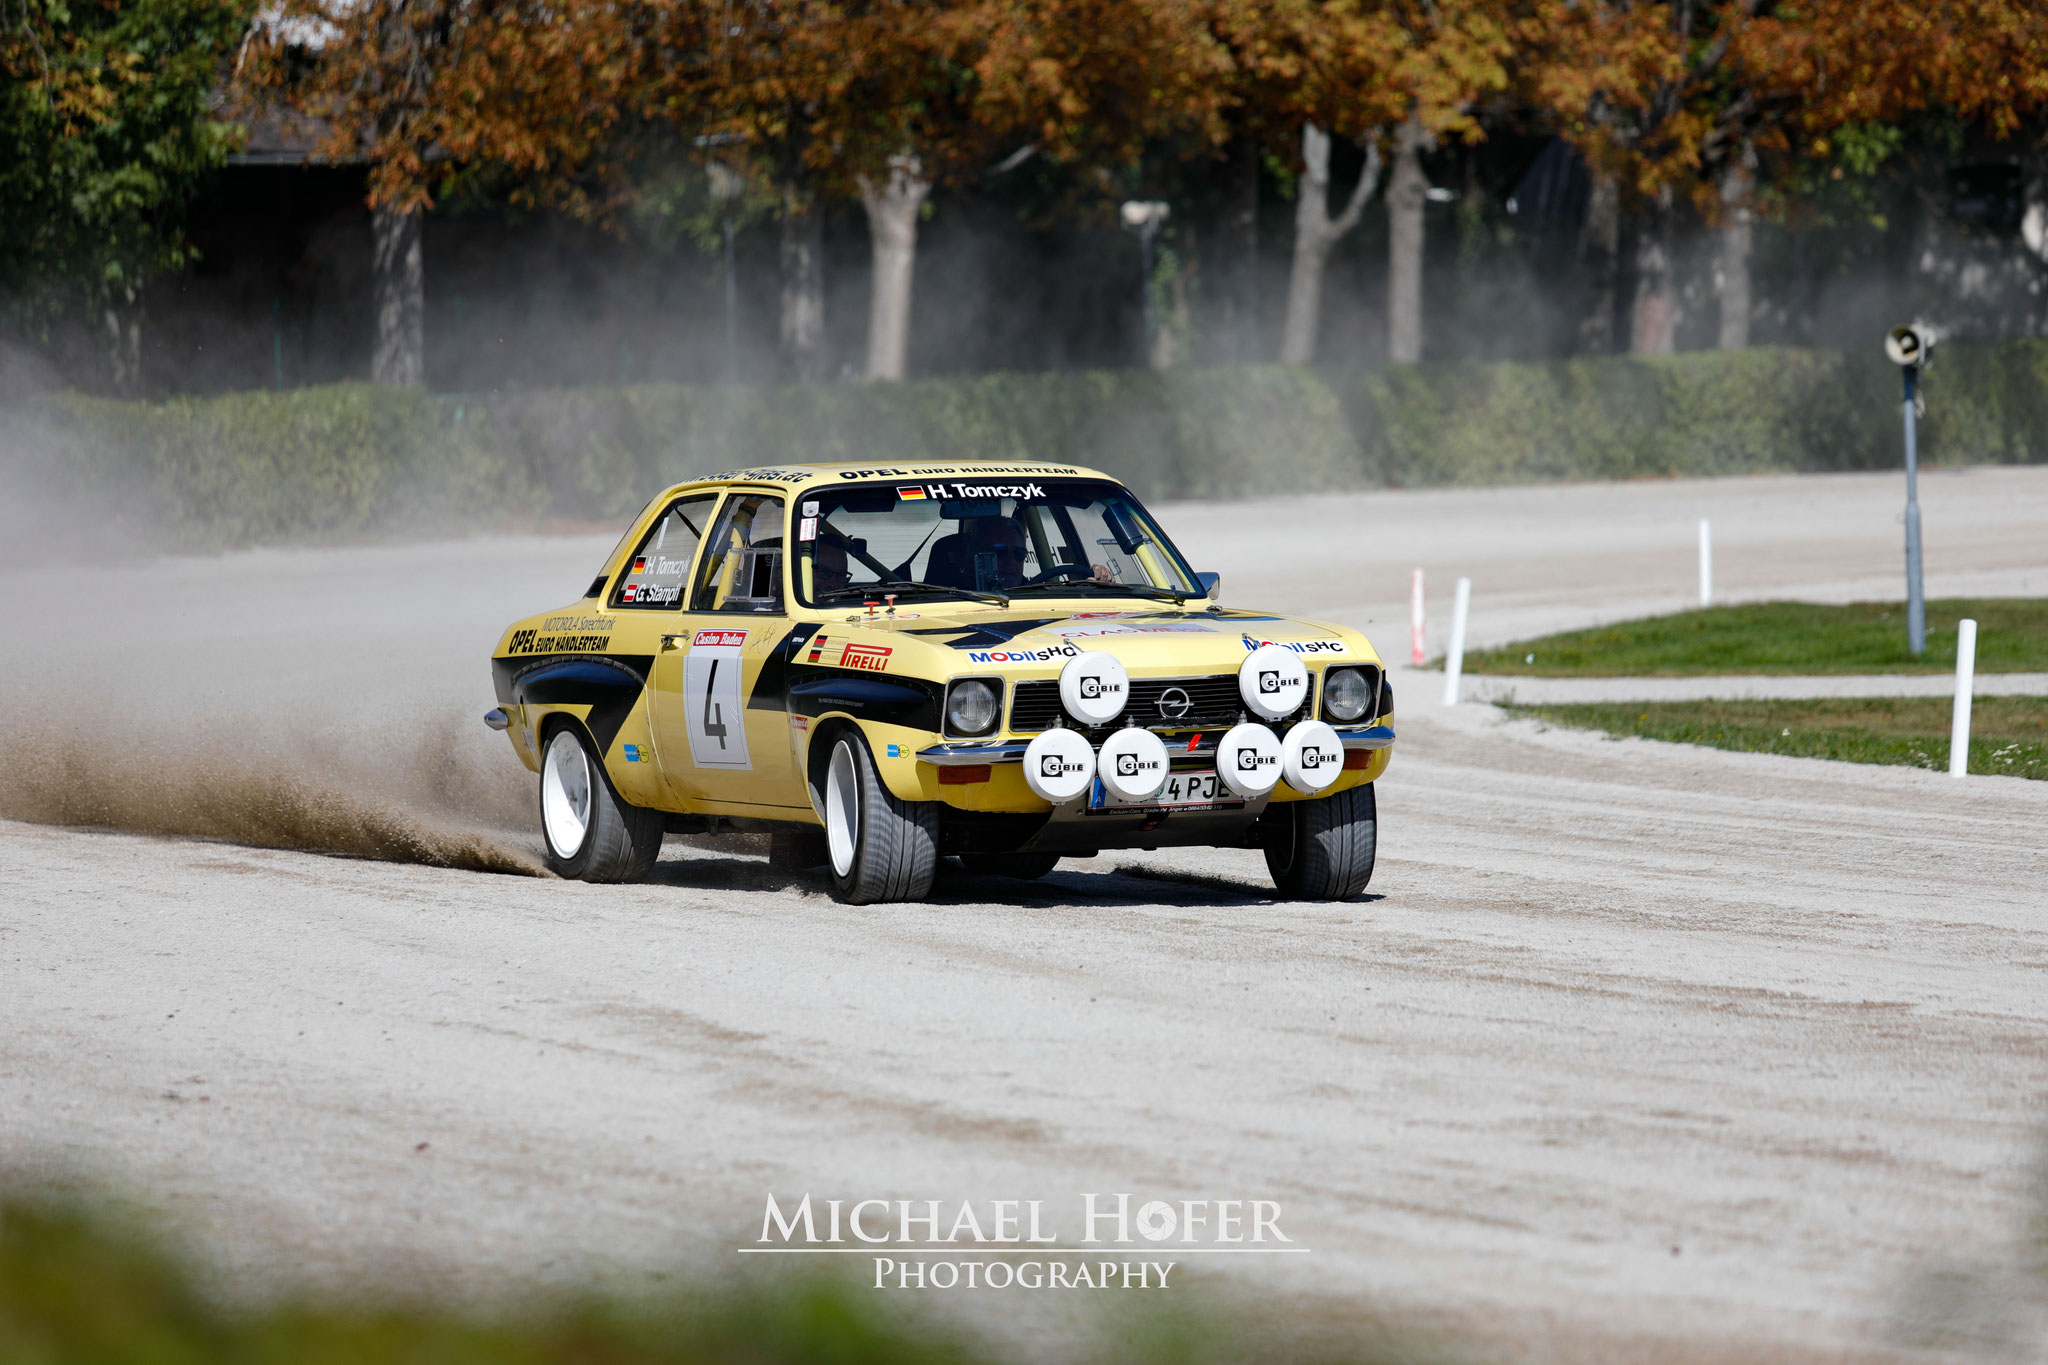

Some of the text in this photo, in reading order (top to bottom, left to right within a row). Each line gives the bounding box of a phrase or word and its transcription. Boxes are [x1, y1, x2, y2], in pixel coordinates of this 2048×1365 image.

[839, 468, 908, 480] OPEL
[927, 483, 1047, 500] H. Tomczyk
[644, 556, 655, 575] H.
[635, 583, 646, 602] G.
[508, 629, 538, 654] OPEL
[535, 636, 556, 653] EURO
[695, 632, 720, 645] Casino
[720, 632, 743, 646] Baden
[1242, 639, 1344, 653] Mil SHC
[839, 643, 893, 671] PIRELLI
[1036, 646, 1078, 661] SHC
[703, 659, 728, 750] 4
